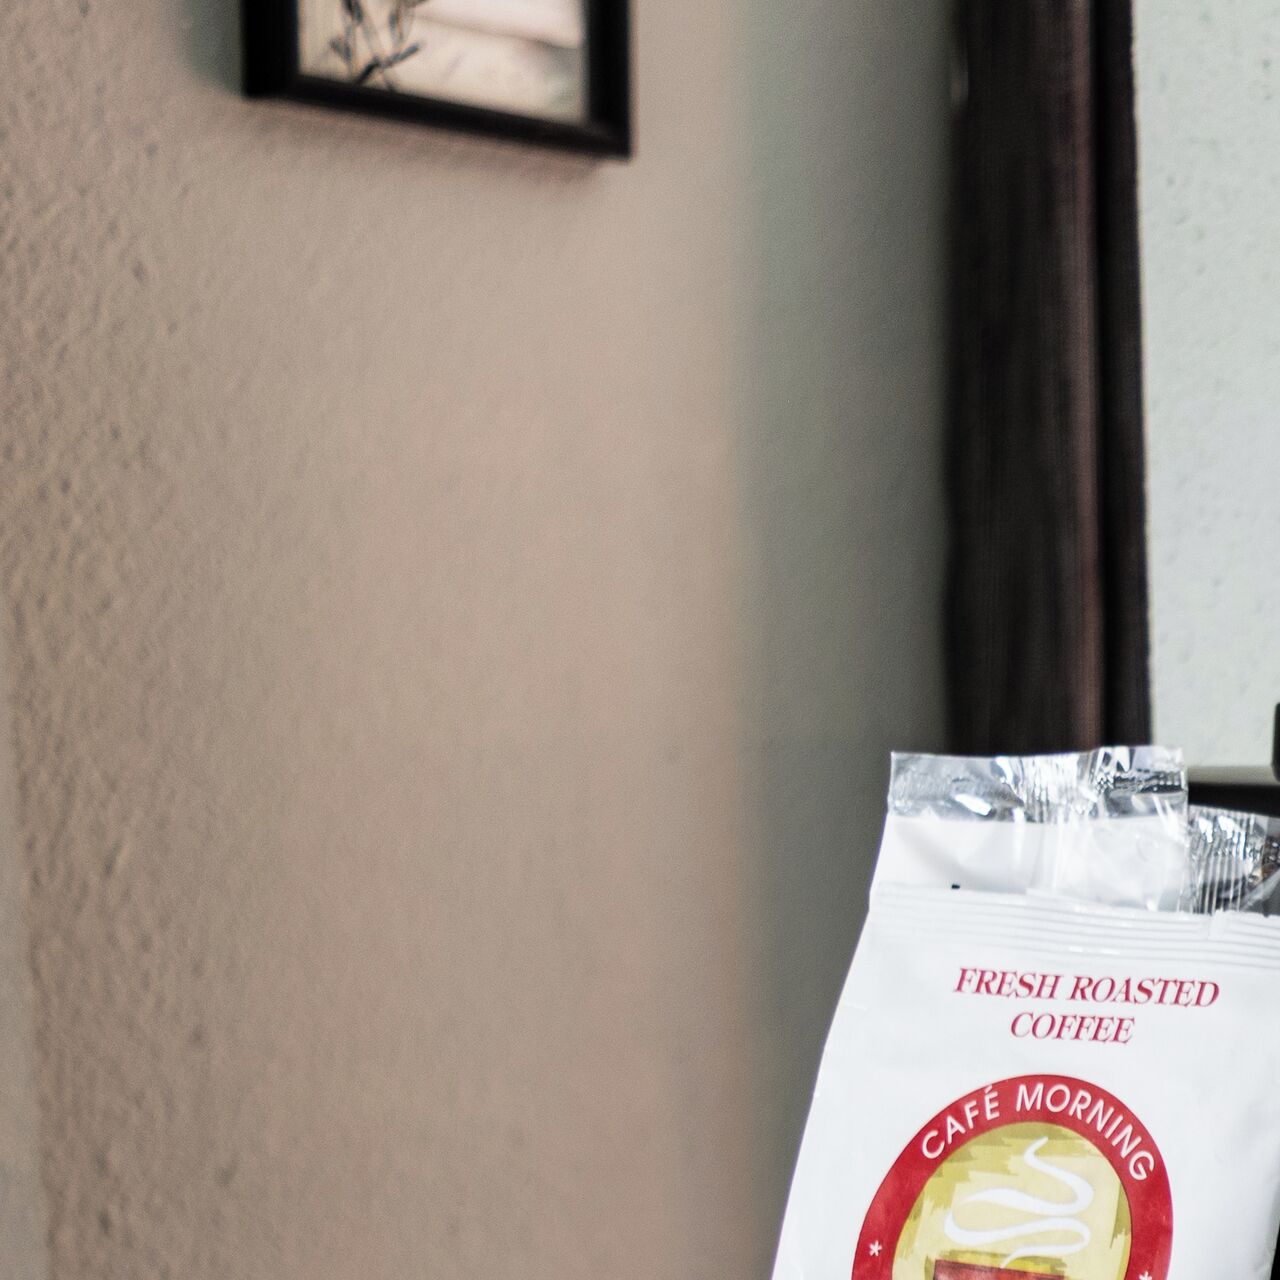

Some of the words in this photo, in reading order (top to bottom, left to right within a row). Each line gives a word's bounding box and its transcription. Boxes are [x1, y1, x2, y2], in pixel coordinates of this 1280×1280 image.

[952, 966, 1062, 1003] FRESH
[1065, 975, 1220, 1009] ROASTED
[1008, 1011, 1137, 1045] COFFEE
[920, 1084, 1002, 1162] CAFÉ
[1014, 1081, 1156, 1184] MORNING
